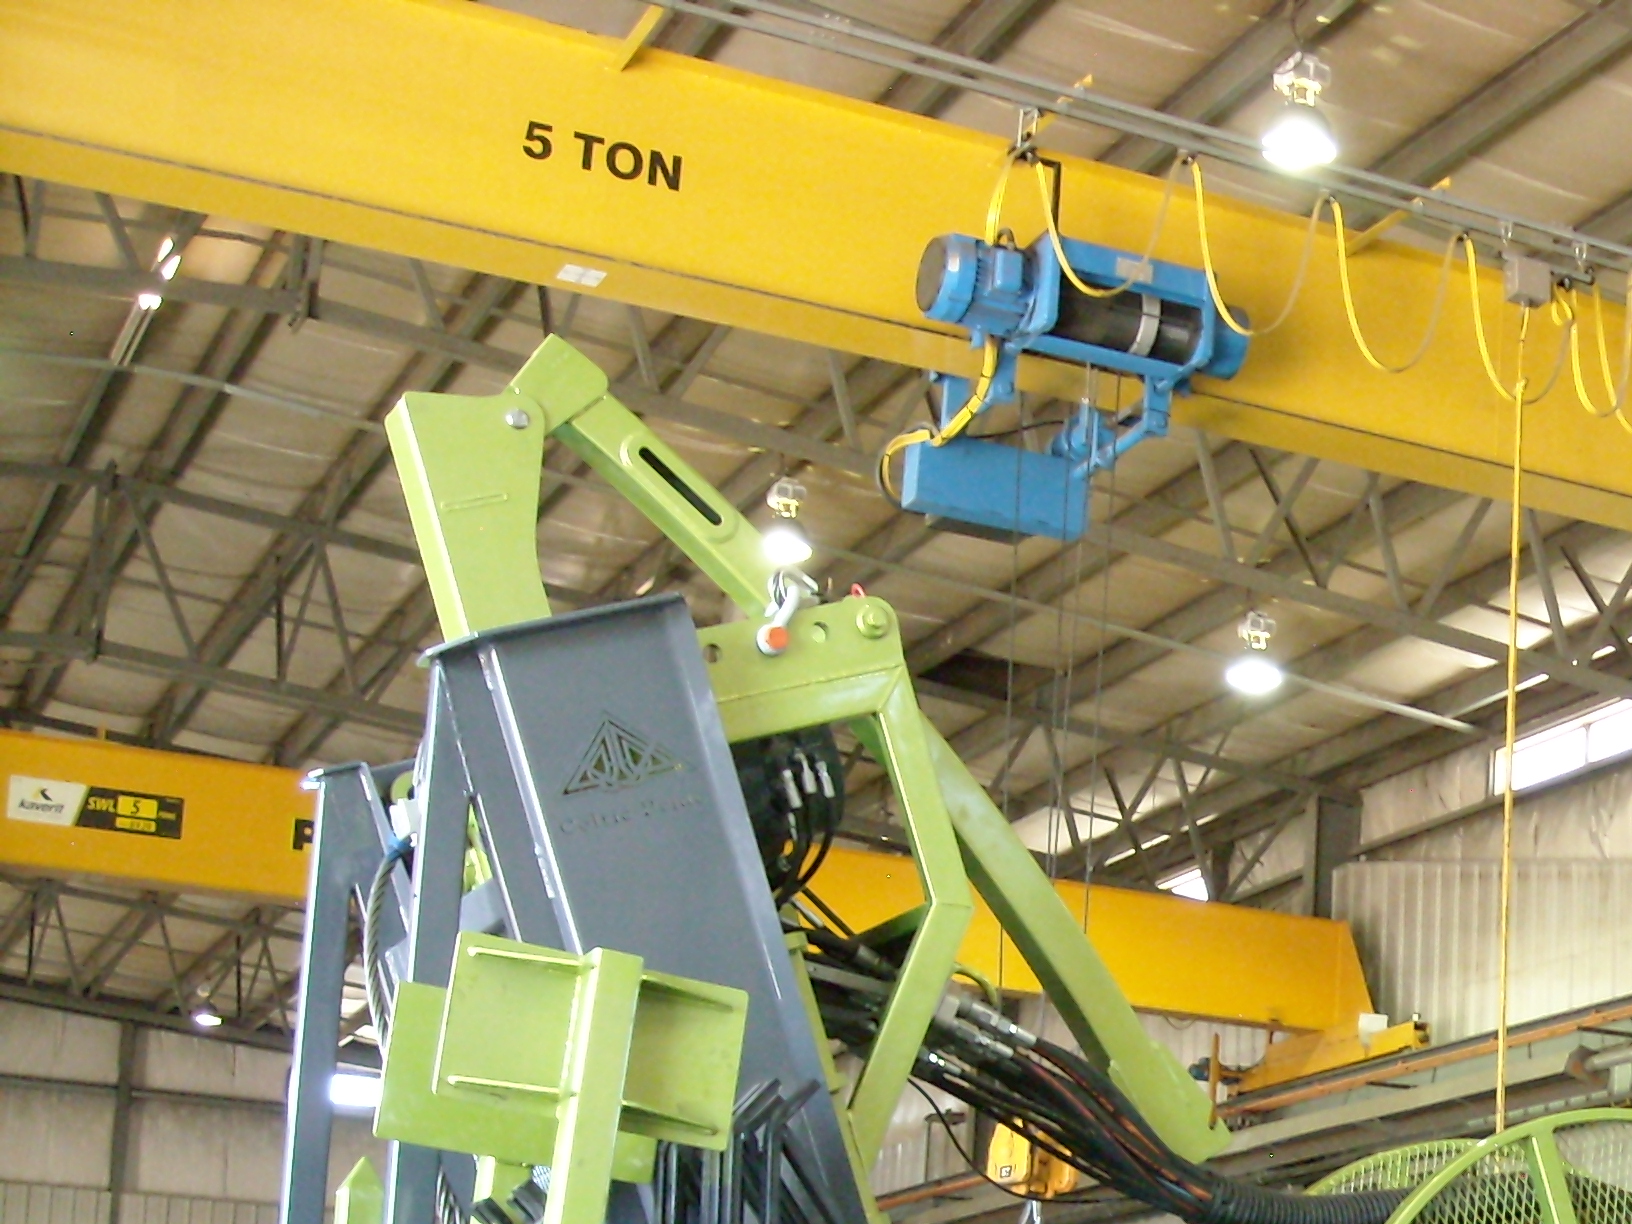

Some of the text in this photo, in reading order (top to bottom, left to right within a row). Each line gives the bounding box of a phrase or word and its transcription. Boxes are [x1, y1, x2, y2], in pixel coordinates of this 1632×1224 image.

[522, 120, 683, 191] 5 TON
[86, 796, 141, 815] SWL 5
